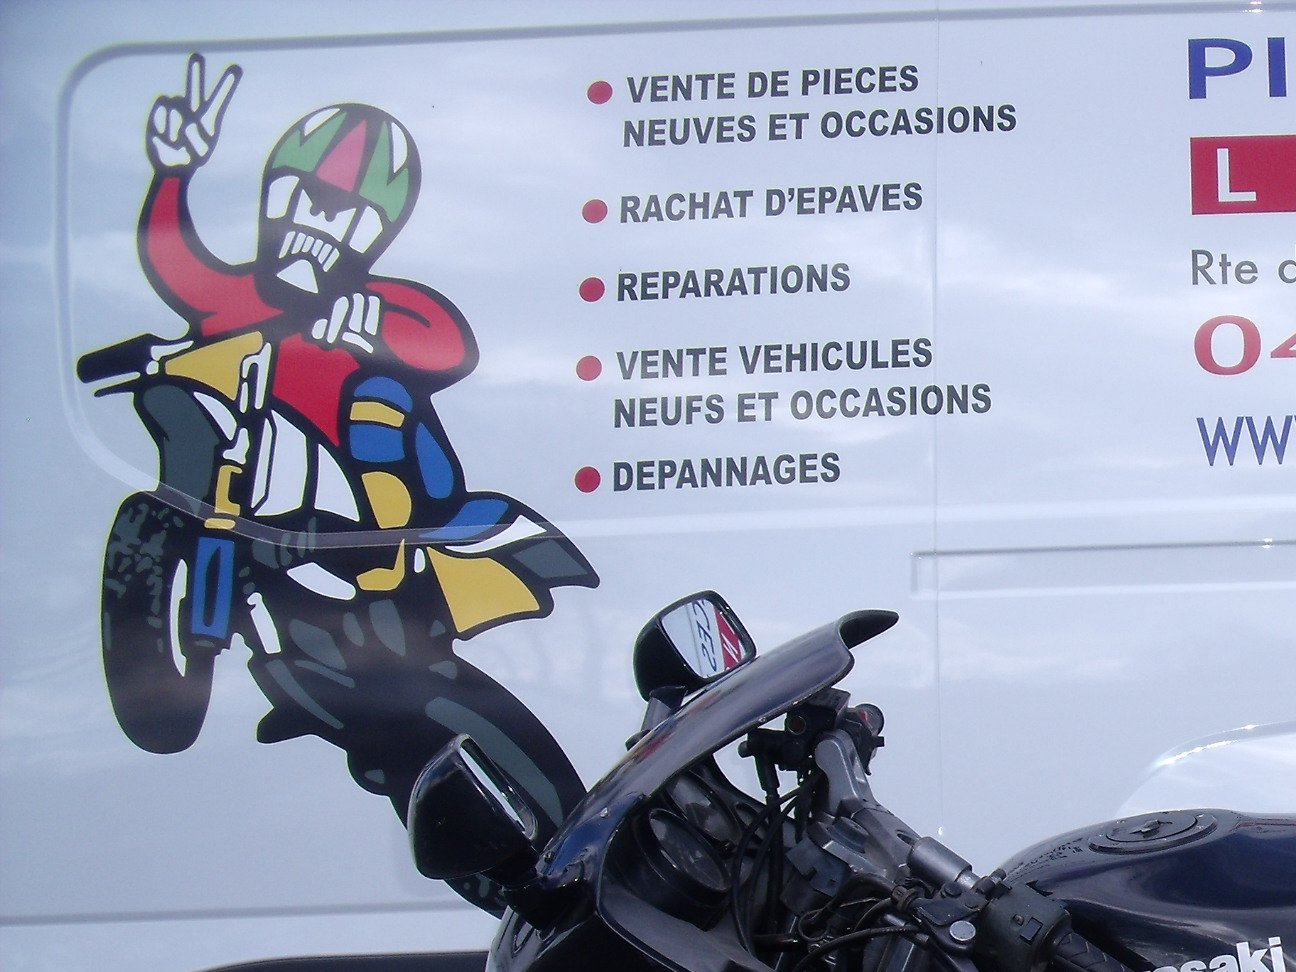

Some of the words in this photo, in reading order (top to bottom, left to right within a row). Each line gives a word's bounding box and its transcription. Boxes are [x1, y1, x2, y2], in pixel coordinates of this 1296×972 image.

[627, 73, 735, 103] VENTE
[748, 71, 789, 98] DE
[802, 65, 918, 96] PIECES
[624, 115, 756, 147] NEUVES
[769, 113, 809, 140] ET
[821, 105, 1016, 138] OCCASIONS
[621, 190, 753, 223] RACHAT
[766, 182, 922, 216] D'EPAVES
[618, 263, 850, 301] REPARATIONS
[1192, 250, 1258, 285] Rte
[616, 347, 727, 380] VENTE
[739, 338, 932, 374] VEHICULES
[614, 394, 724, 428] NEUFS
[738, 392, 778, 422] ET
[791, 384, 991, 420] OCCASIONS
[614, 453, 840, 492] DEPANNAGES
